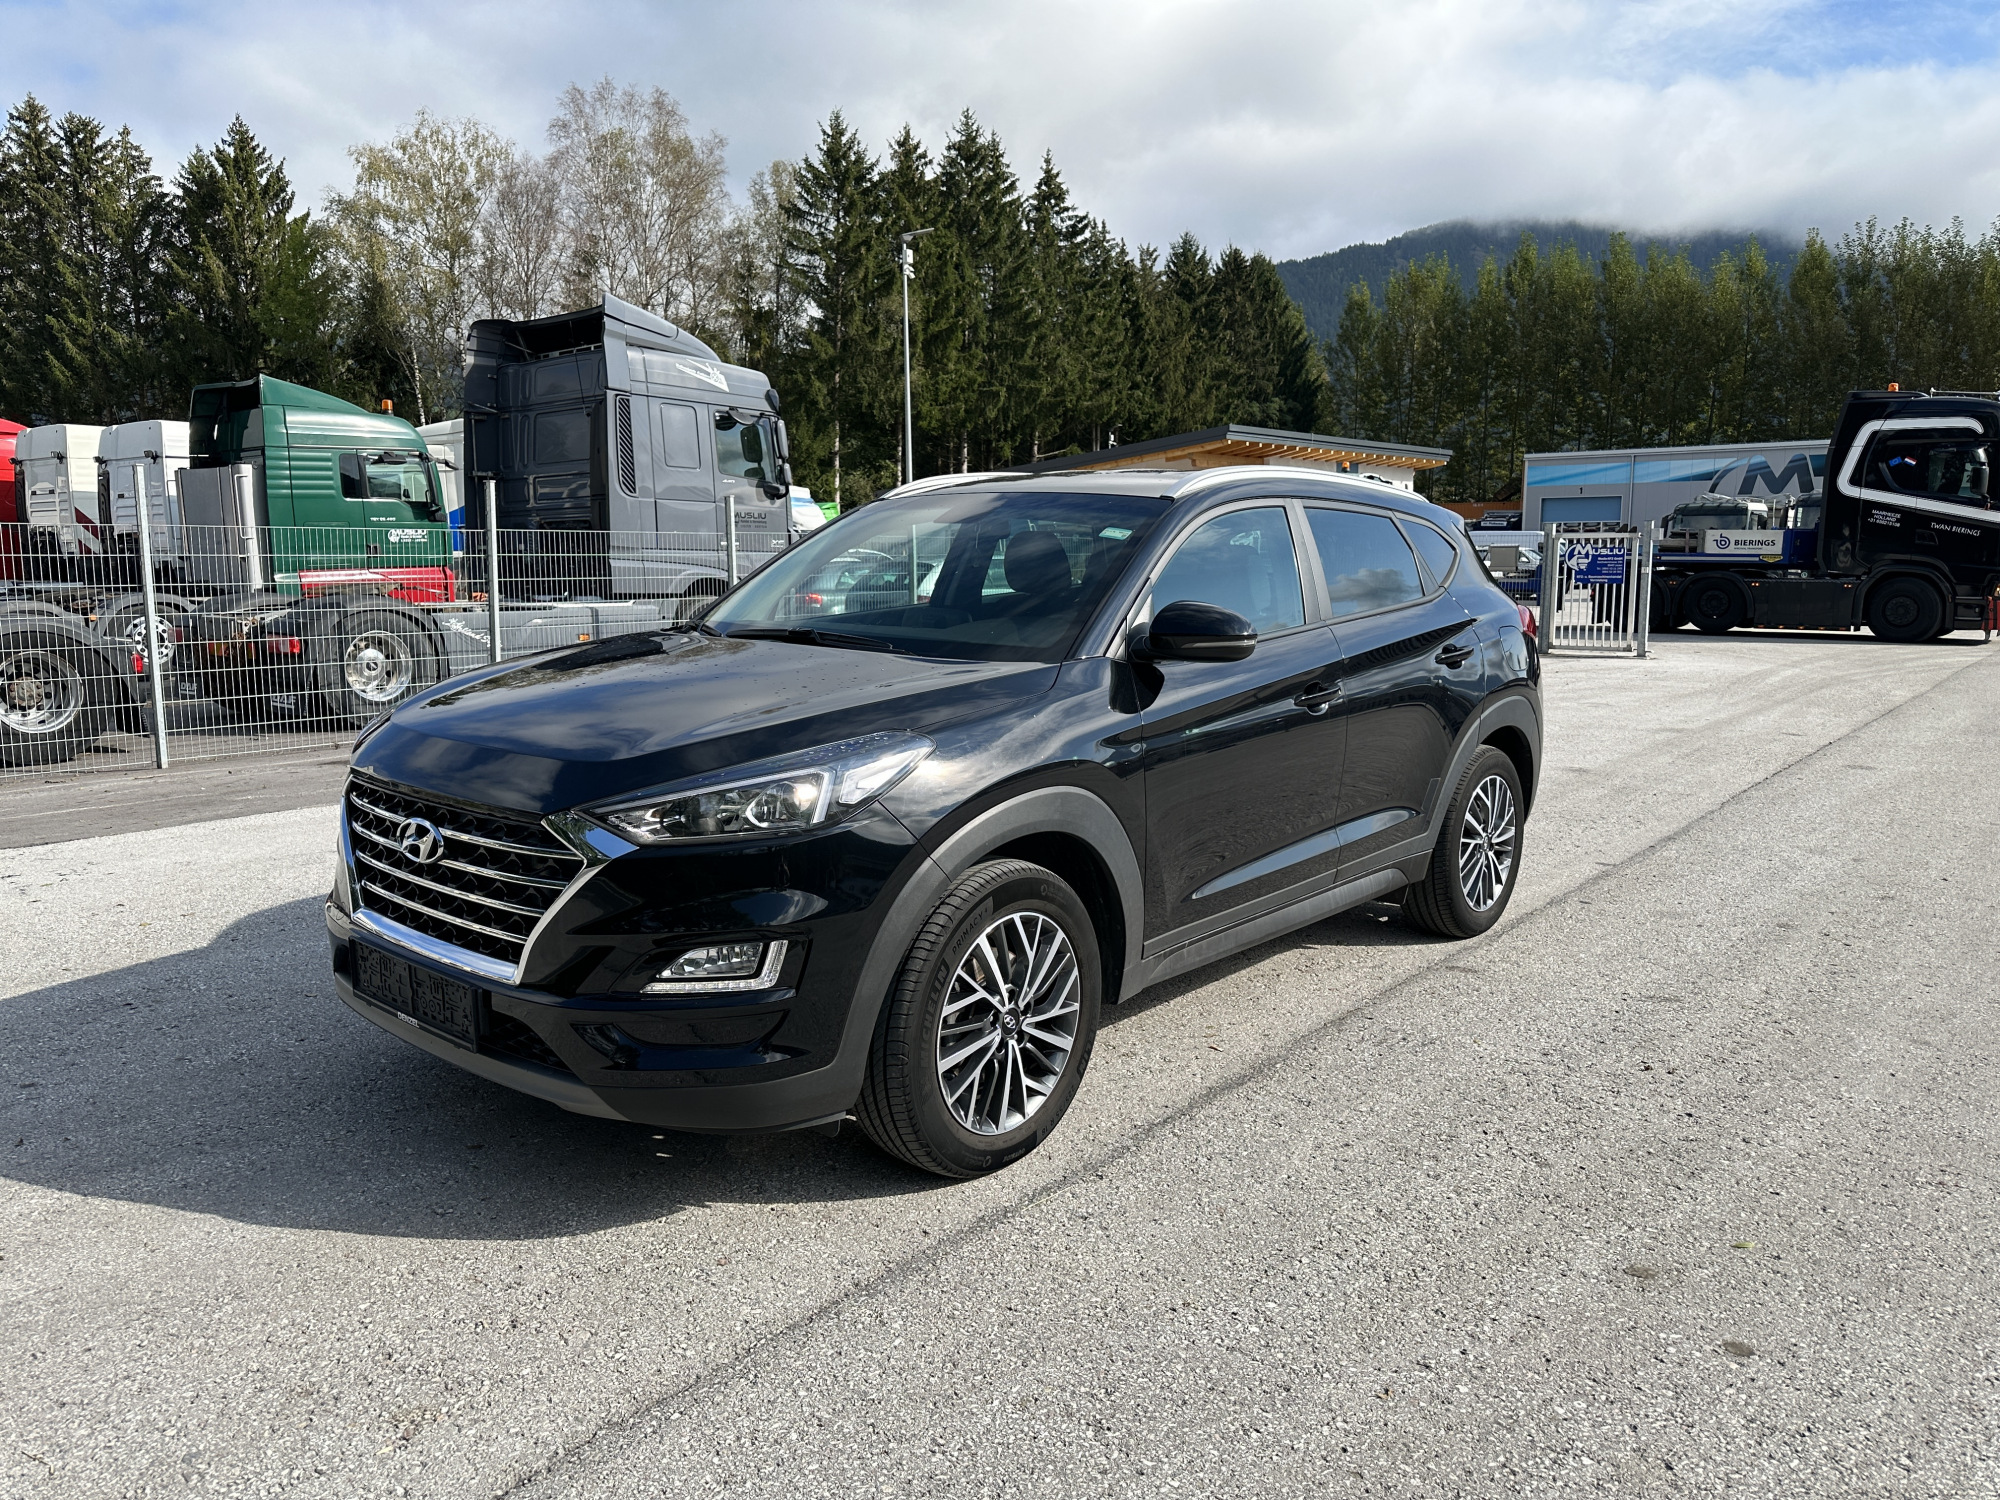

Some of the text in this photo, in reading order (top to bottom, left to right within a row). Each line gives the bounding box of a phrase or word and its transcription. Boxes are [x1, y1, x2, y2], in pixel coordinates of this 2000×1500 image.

[1579, 487, 1583, 495] 1
[1931, 522, 1980, 537] TWAN BIERINGS
[1574, 543, 1624, 554] MUSLIU
[1734, 539, 1776, 547] BIERINGS
[952, 914, 984, 955] PRIMACY
[397, 1011, 420, 1028] DENZEL
[919, 957, 950, 1070] MICHELIN
